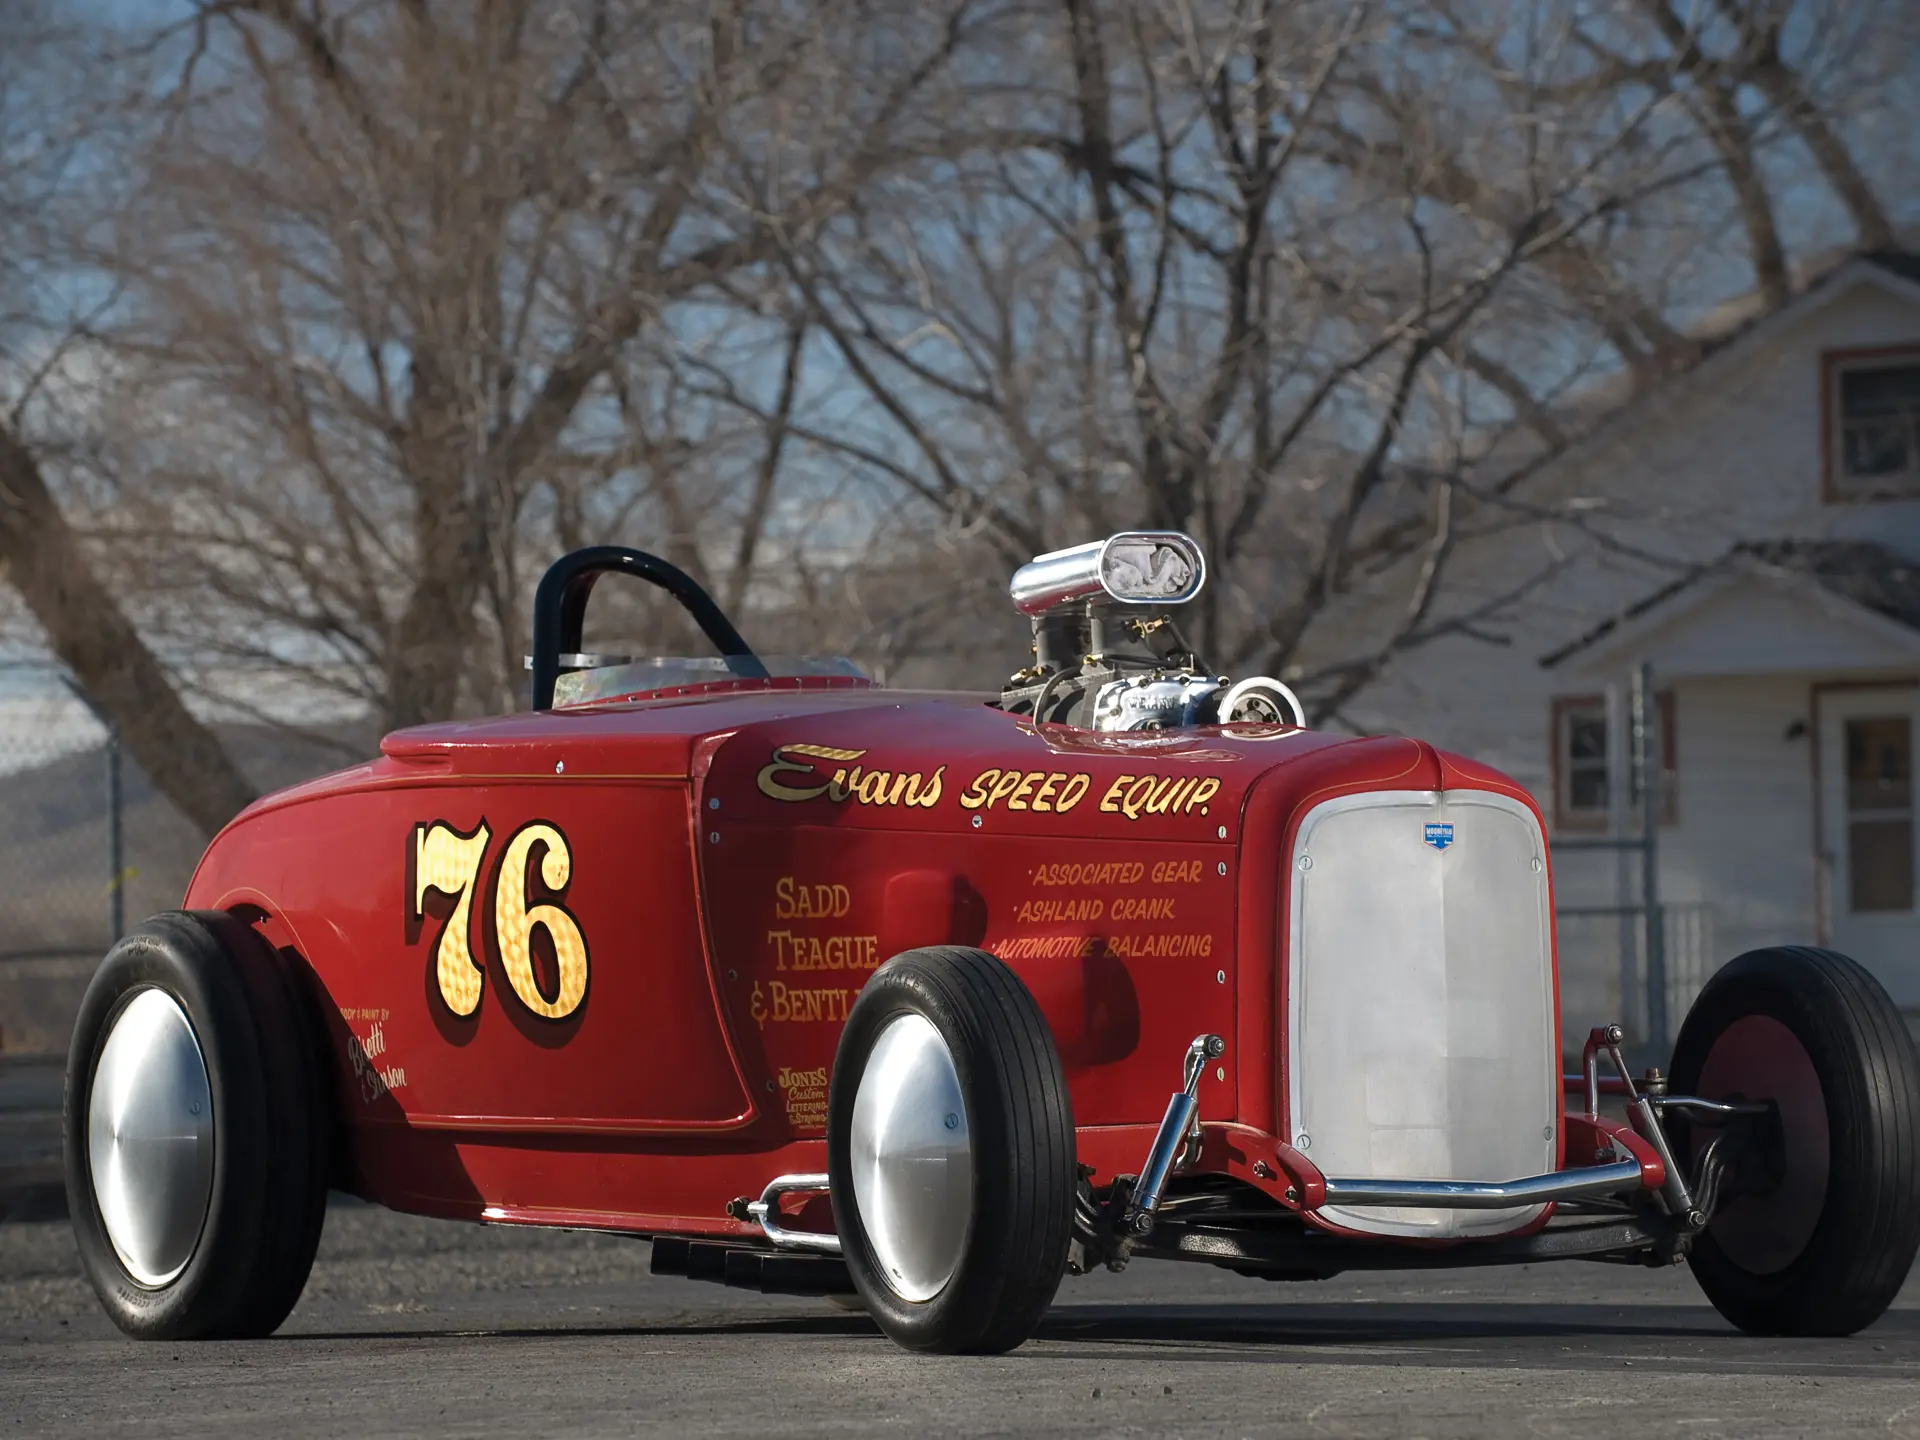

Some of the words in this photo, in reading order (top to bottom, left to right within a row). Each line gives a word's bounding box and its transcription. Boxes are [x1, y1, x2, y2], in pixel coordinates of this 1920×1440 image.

[756, 742, 946, 810] Evans
[959, 768, 1091, 812] SPEED
[1099, 774, 1222, 821] EQUIP.
[1033, 863, 1145, 886] ASSOCIATED
[1151, 860, 1203, 883] GEAR
[776, 876, 850, 919] SADD
[1017, 899, 1104, 923] ASHLAND
[1110, 898, 1176, 921] CRANK
[408, 815, 592, 1035] 76
[768, 929, 880, 971] TEAGUE
[994, 936, 1098, 960] AUTOMOTIVE
[1103, 934, 1213, 958] BALANCING
[751, 980, 768, 1031] &
[778, 1067, 827, 1088] JONES
[788, 1087, 825, 1100] Custom
